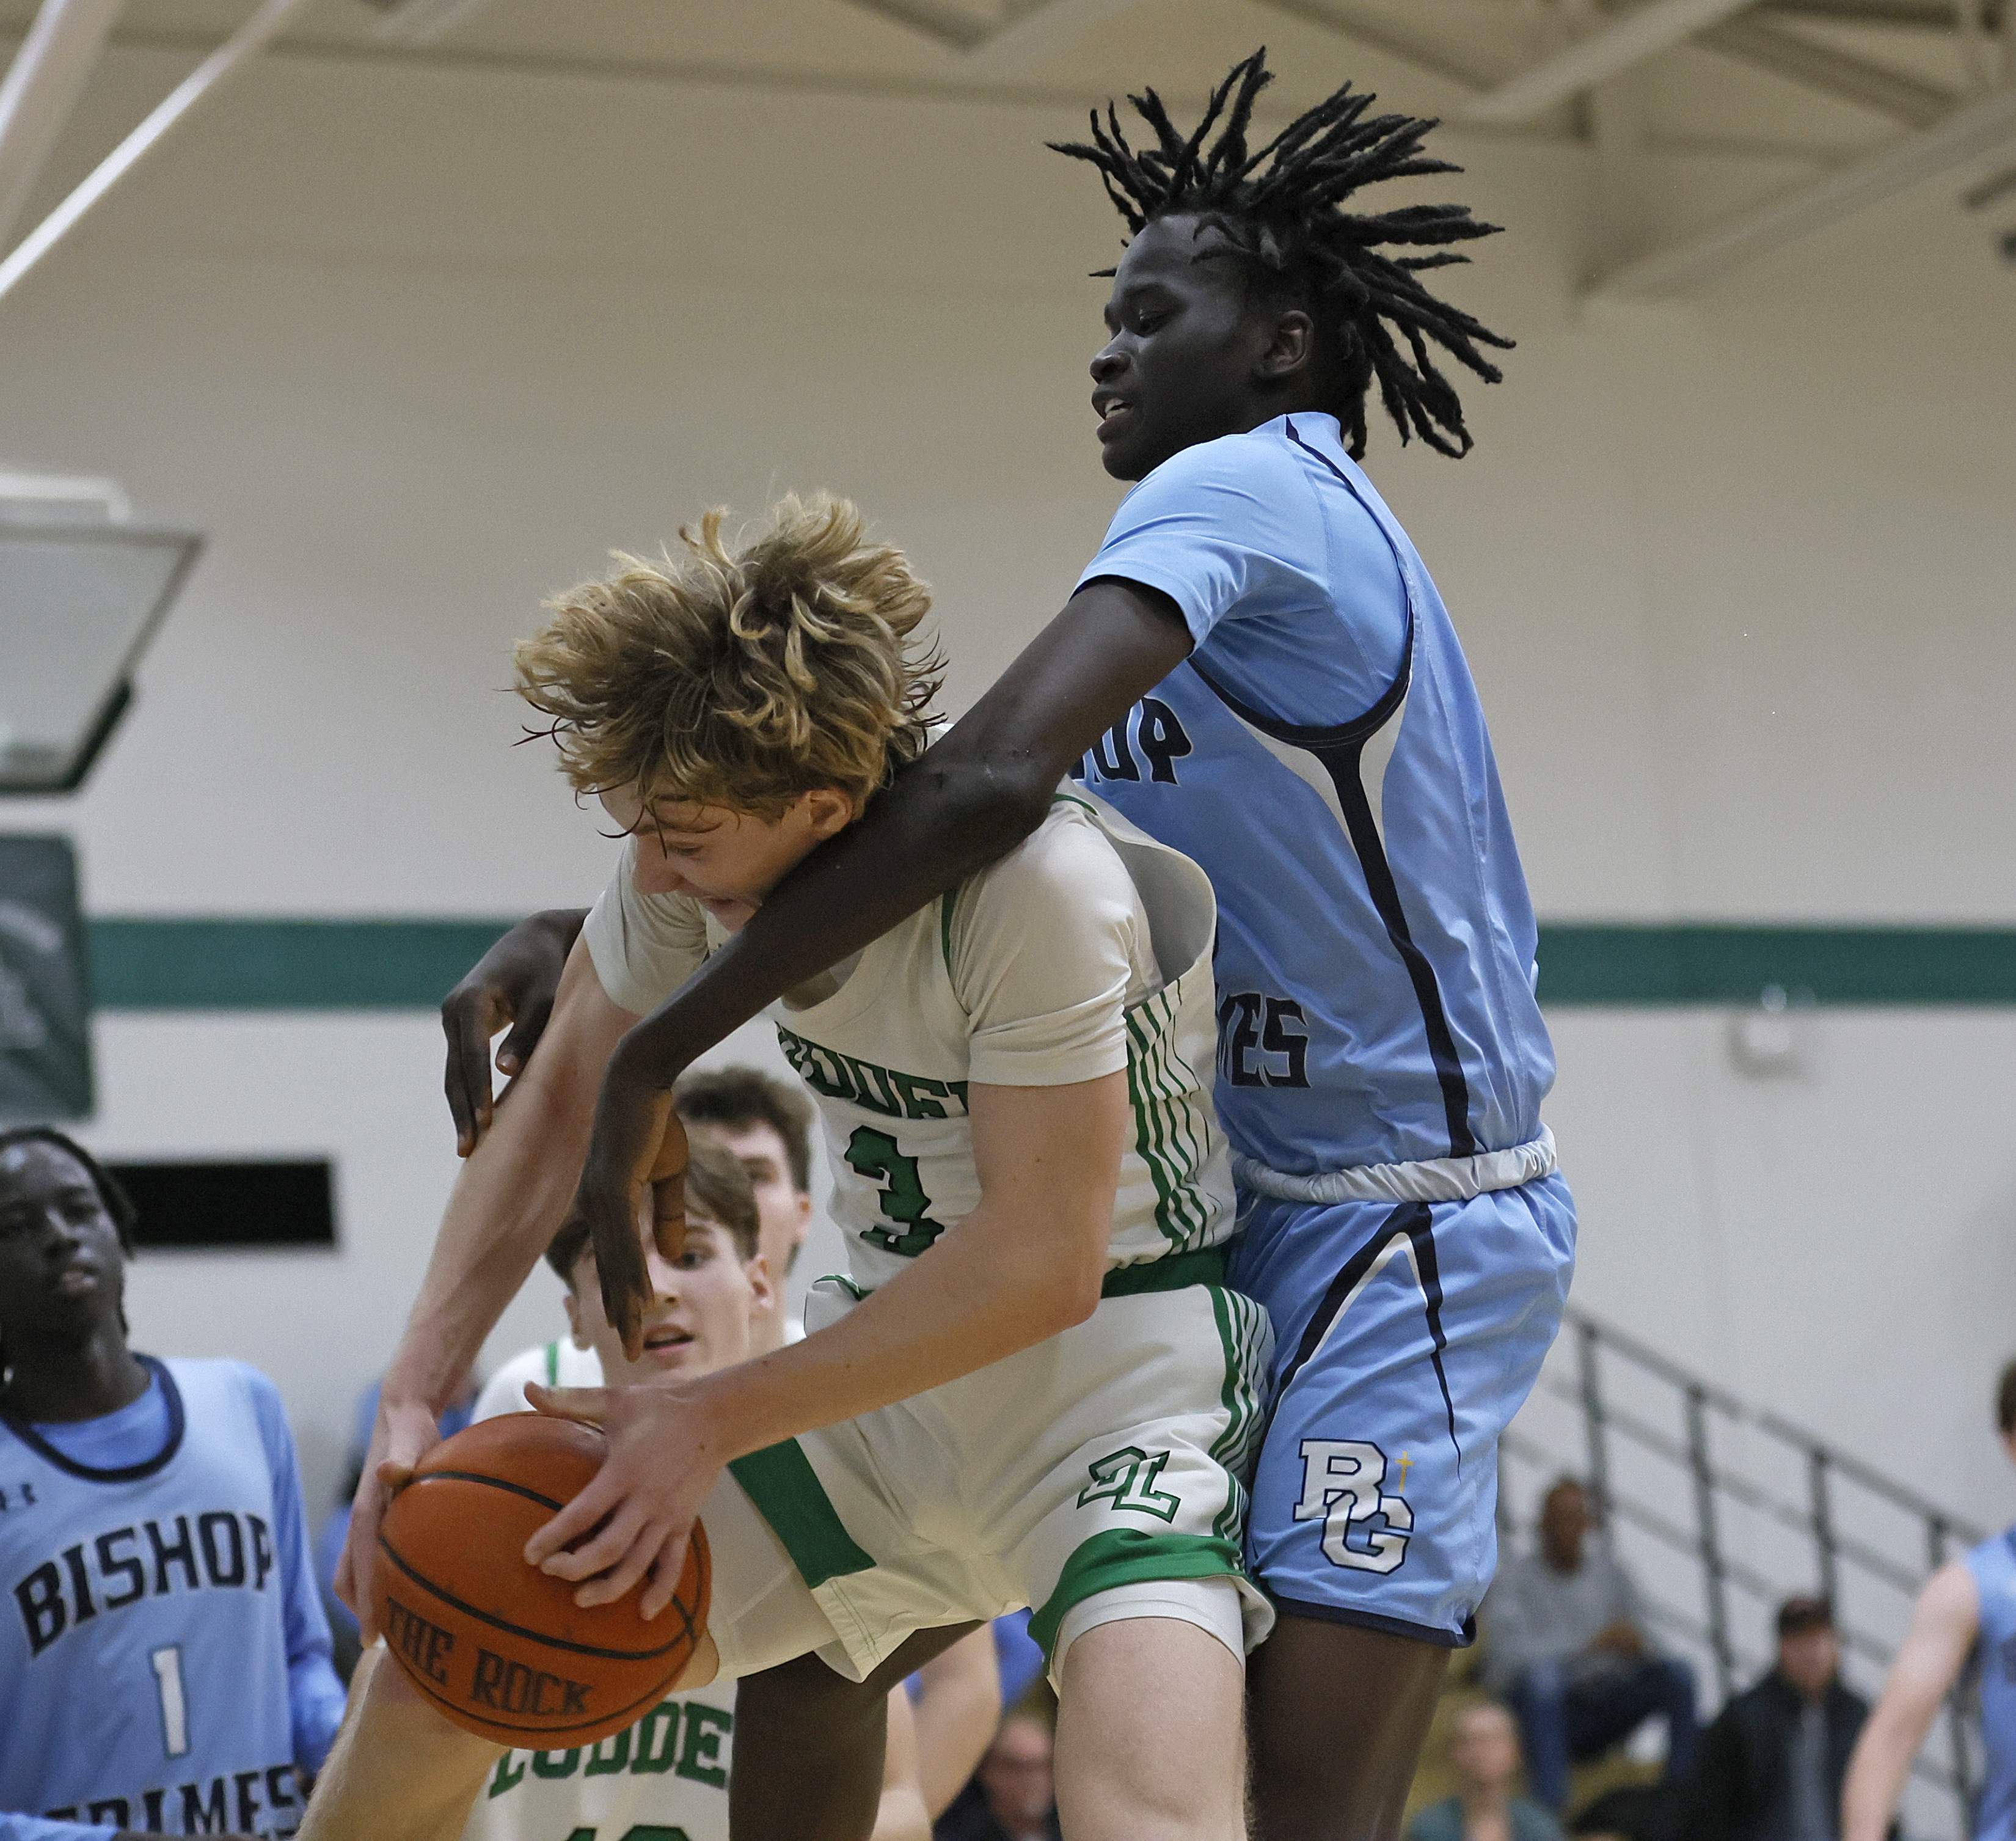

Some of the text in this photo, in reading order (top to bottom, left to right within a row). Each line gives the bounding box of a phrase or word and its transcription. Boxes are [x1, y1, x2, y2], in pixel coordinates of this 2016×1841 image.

[844, 1124, 945, 1257] 3
[13, 1510, 272, 1658] BISHOP
[148, 1642, 195, 1762] 1
[387, 1595, 595, 1716] THE ROCK
